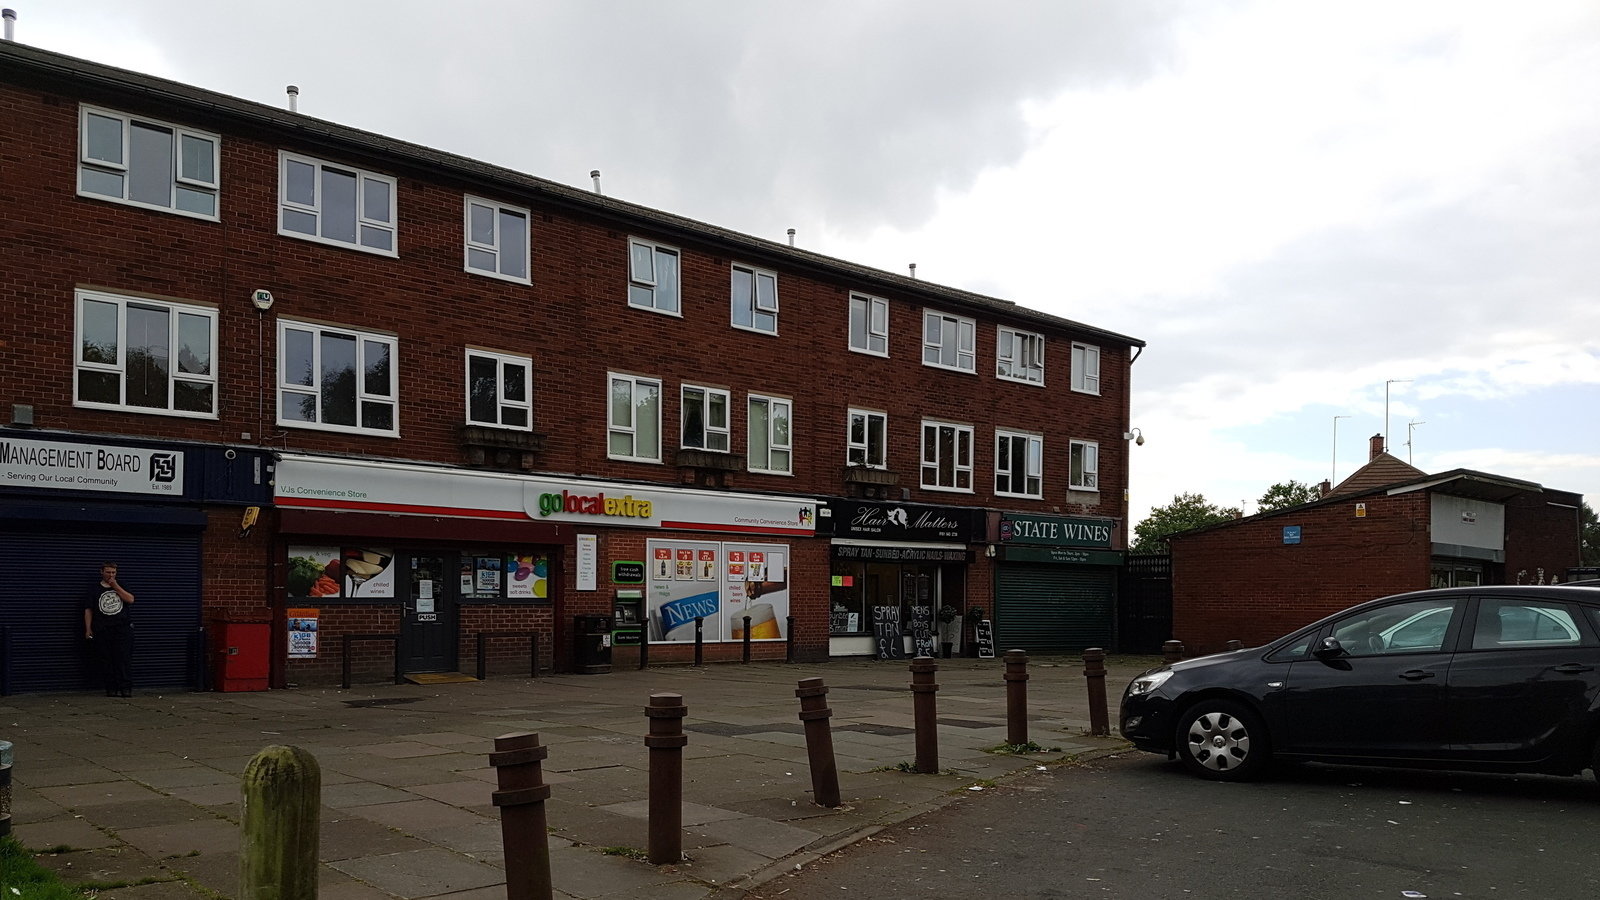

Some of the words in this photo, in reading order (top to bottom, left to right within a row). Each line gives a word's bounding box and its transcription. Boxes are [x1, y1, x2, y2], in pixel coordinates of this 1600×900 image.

[0, 442, 93, 469] MANAGEMENT
[97, 449, 141, 472] BOARD
[7, 472, 36, 482] Serving
[39, 474, 53, 482] Our
[55, 475, 75, 483] Local
[77, 476, 119, 487] Community
[297, 487, 346, 497] Convenience
[347, 490, 367, 499] Store
[734, 516, 760, 524] Community
[760, 518, 787, 526] Convenience
[851, 507, 888, 526] Hair
[907, 511, 959, 529] Matters
[1012, 521, 1059, 539] STATE
[1064, 523, 1109, 542] WINES
[665, 599, 716, 626] NEWS
[874, 606, 900, 624] SPRAY
[911, 606, 930, 616] MENS
[875, 622, 900, 637] TAN
